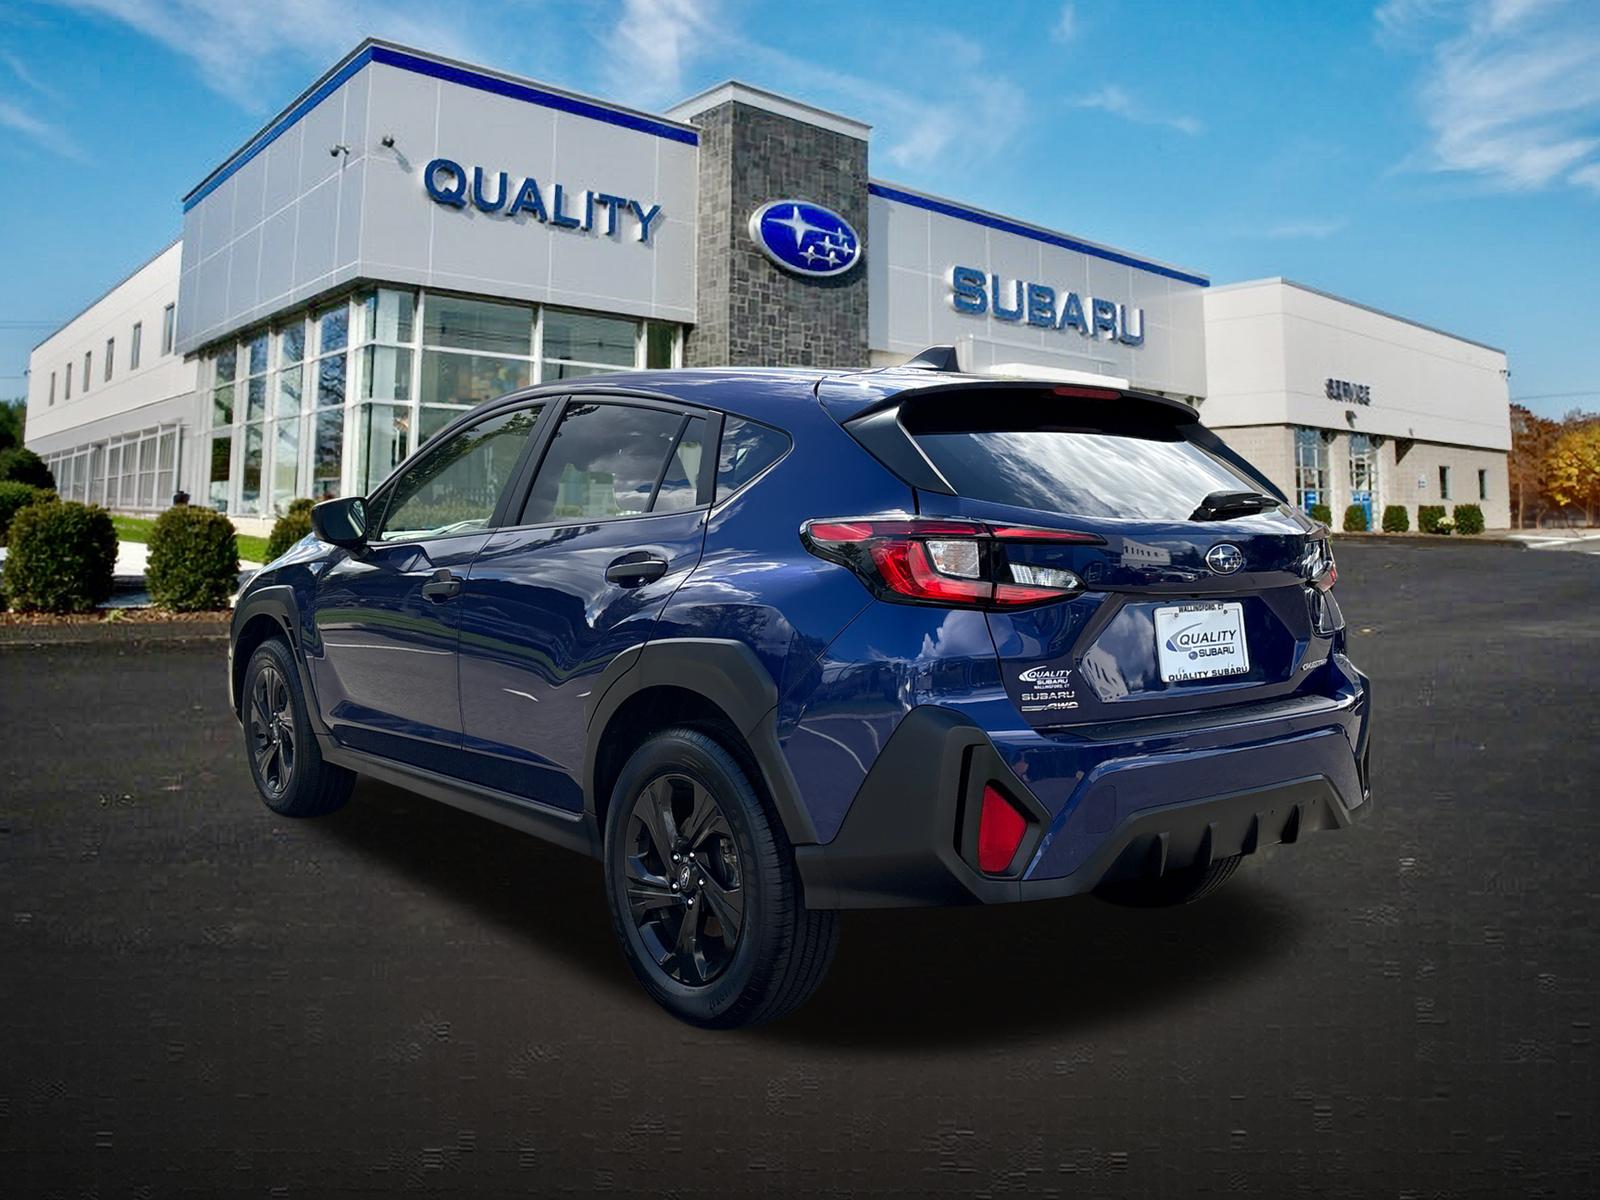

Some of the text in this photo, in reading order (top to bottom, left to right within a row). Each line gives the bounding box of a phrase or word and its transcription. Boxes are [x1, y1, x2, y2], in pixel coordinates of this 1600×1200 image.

[424, 158, 662, 243] QUALITY
[952, 265, 1145, 347] SUBARU
[1325, 378, 1371, 407] SERVICE
[1180, 629, 1237, 646] QUALITY
[1198, 646, 1235, 658] SUBARU
[1028, 670, 1072, 678] QUALITY
[1168, 666, 1248, 681] QUALITY SUBARU
[1022, 691, 1074, 700] SUBARU
[1044, 702, 1078, 710] AWD
